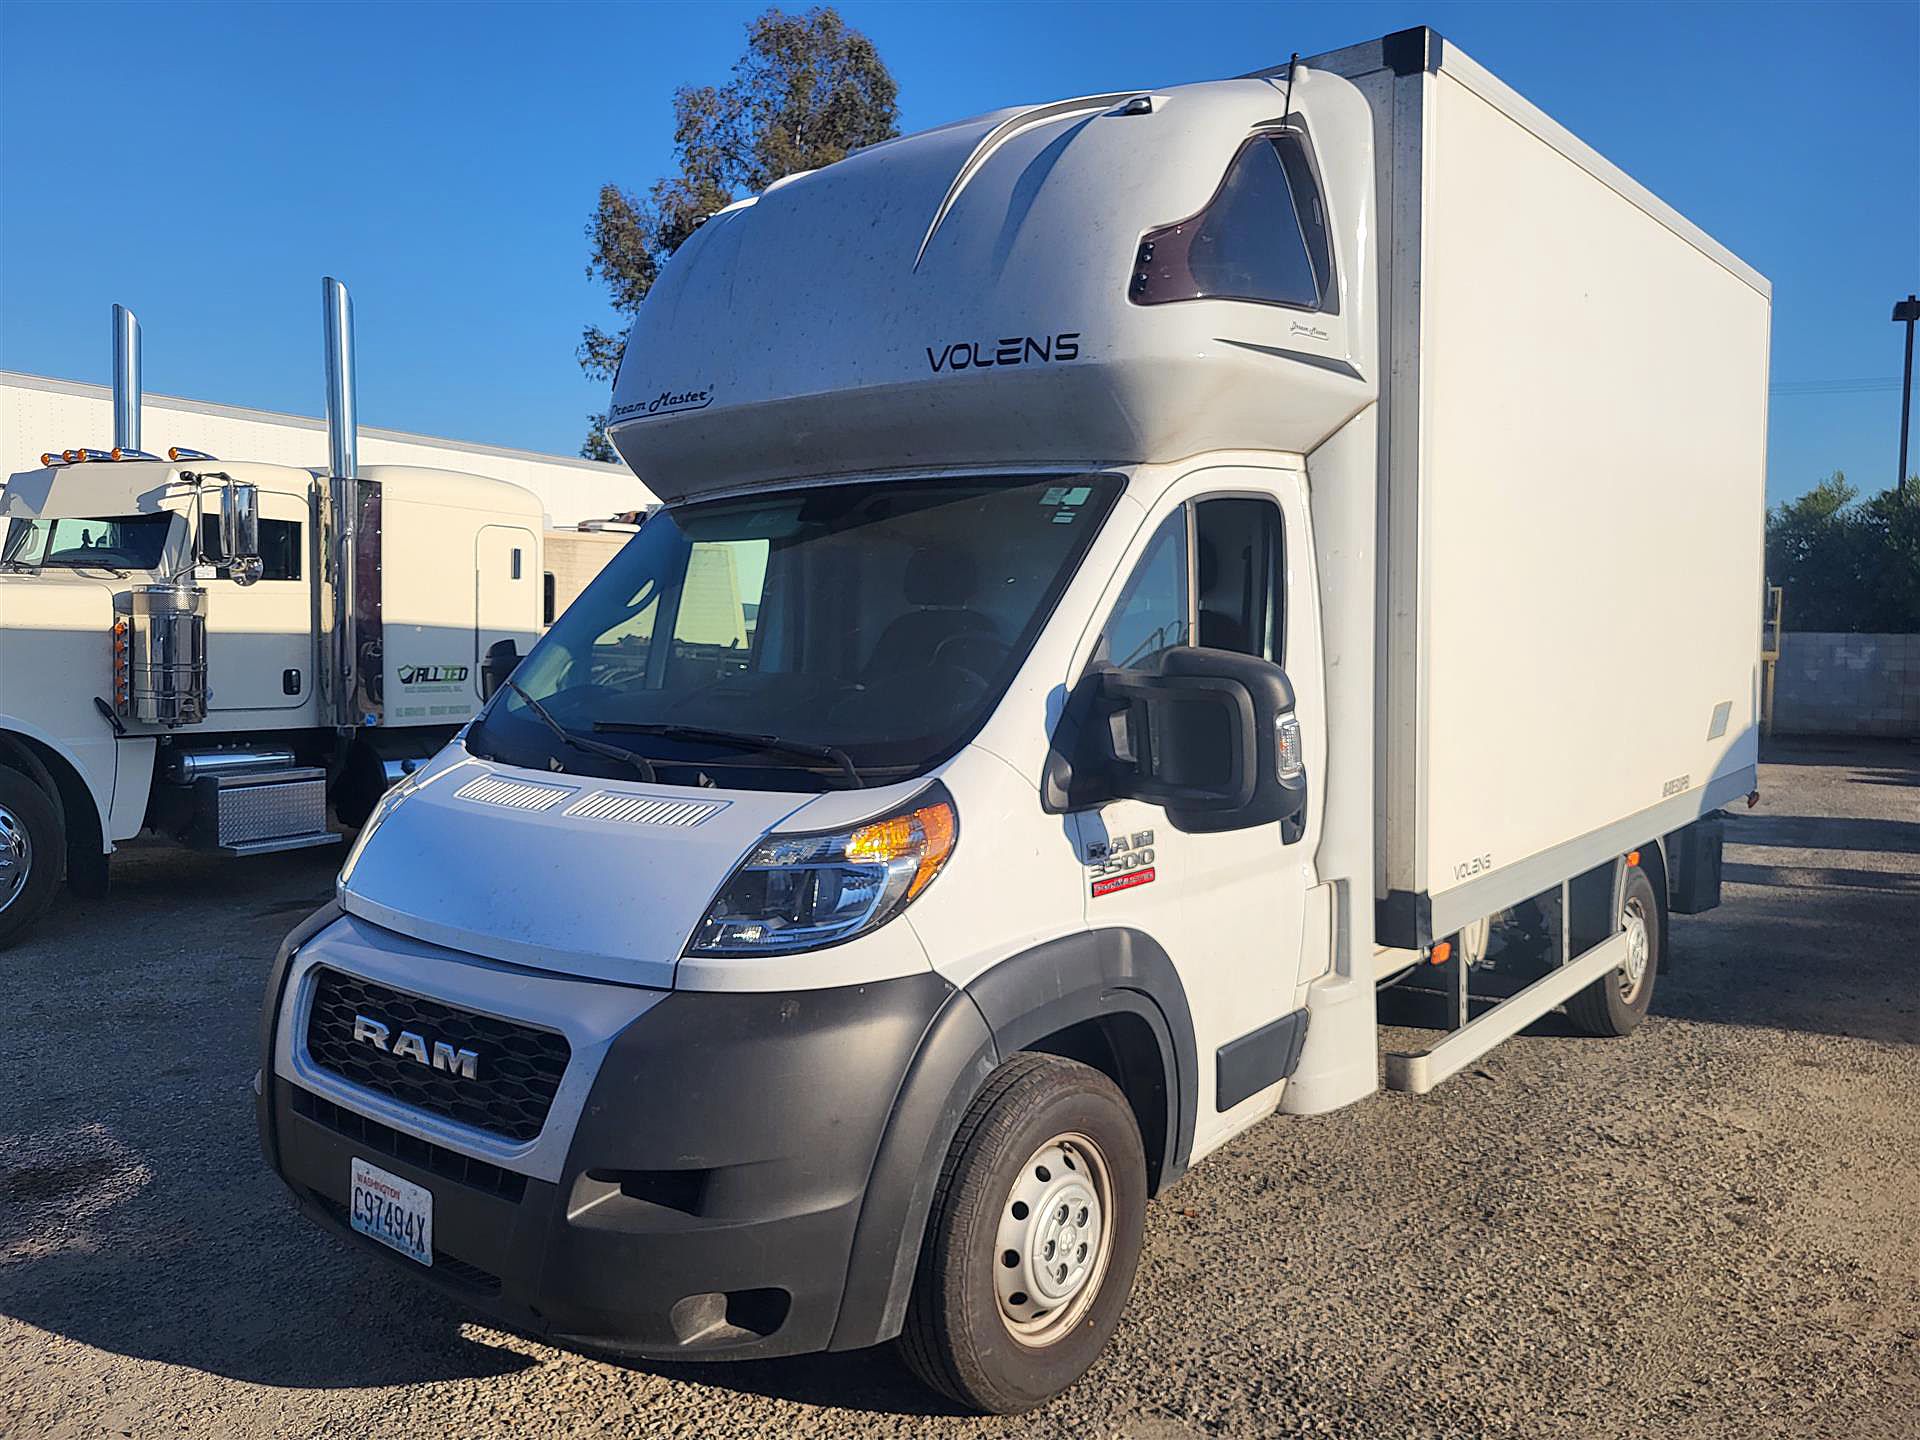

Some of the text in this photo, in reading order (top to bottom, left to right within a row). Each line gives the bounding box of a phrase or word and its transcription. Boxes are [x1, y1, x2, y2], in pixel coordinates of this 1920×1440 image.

[926, 333, 1081, 373] VOLENS
[1086, 829, 1154, 860] RAM
[1453, 853, 1491, 880] VOLENS
[353, 1014, 479, 1081] RAM
[356, 1173, 401, 1201] WASHINGTON
[354, 1187, 426, 1253] C97494X
